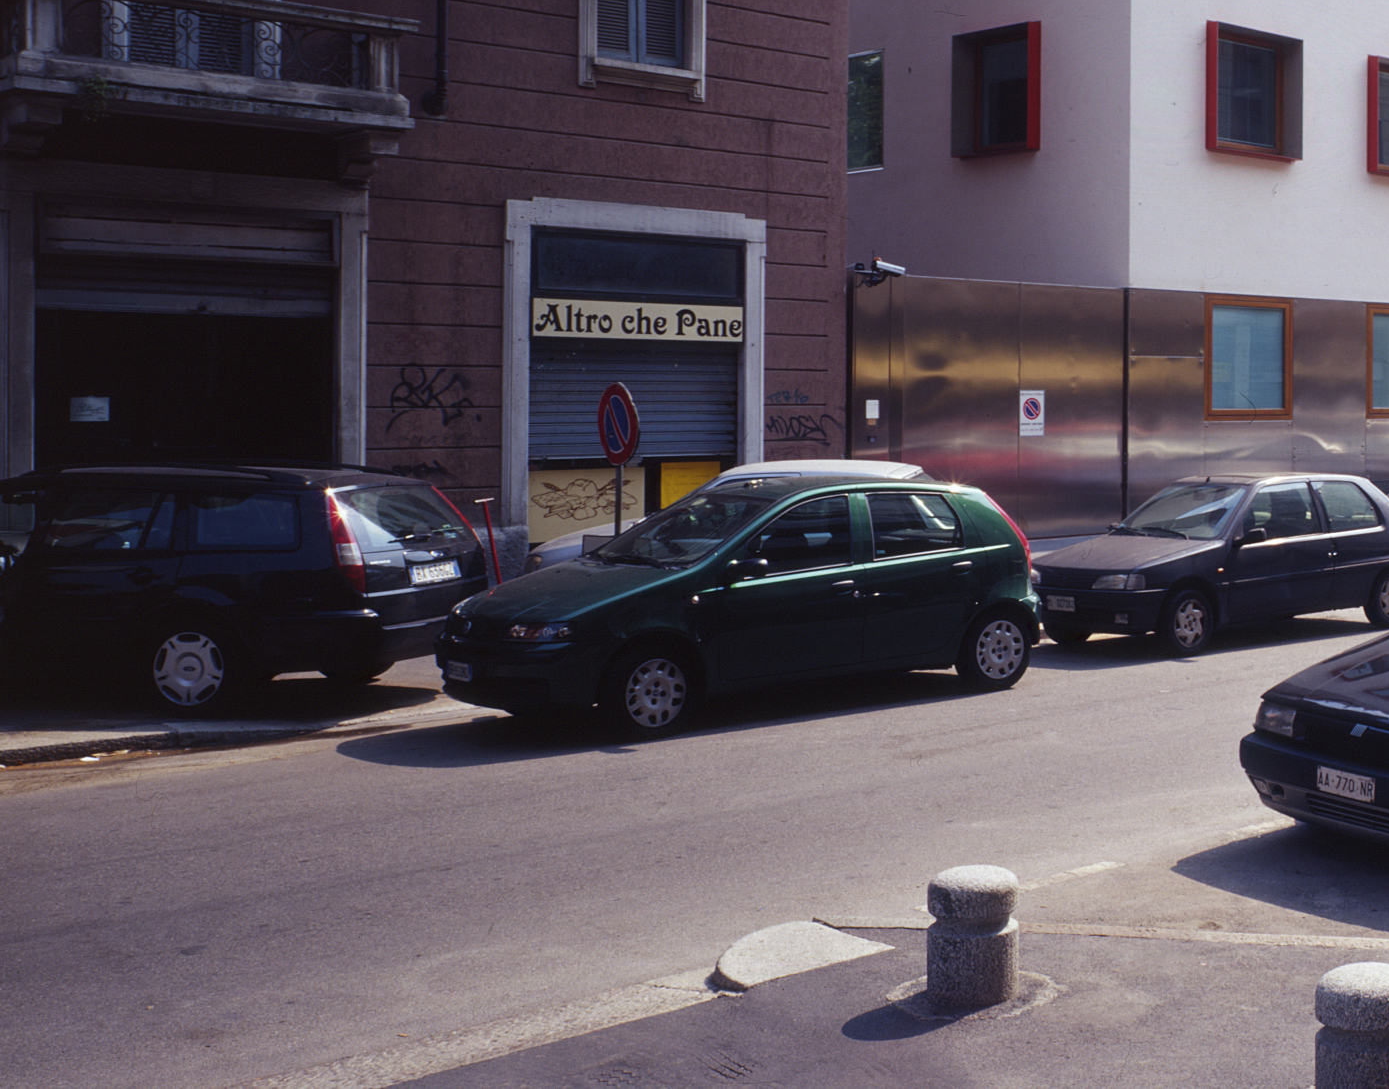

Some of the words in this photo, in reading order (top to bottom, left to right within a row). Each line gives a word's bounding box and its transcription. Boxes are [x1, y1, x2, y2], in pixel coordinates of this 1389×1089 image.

[534, 303, 613, 334] Altro
[621, 307, 667, 335] che
[675, 309, 742, 338] Pane
[1360, 781, 1374, 798] NR
